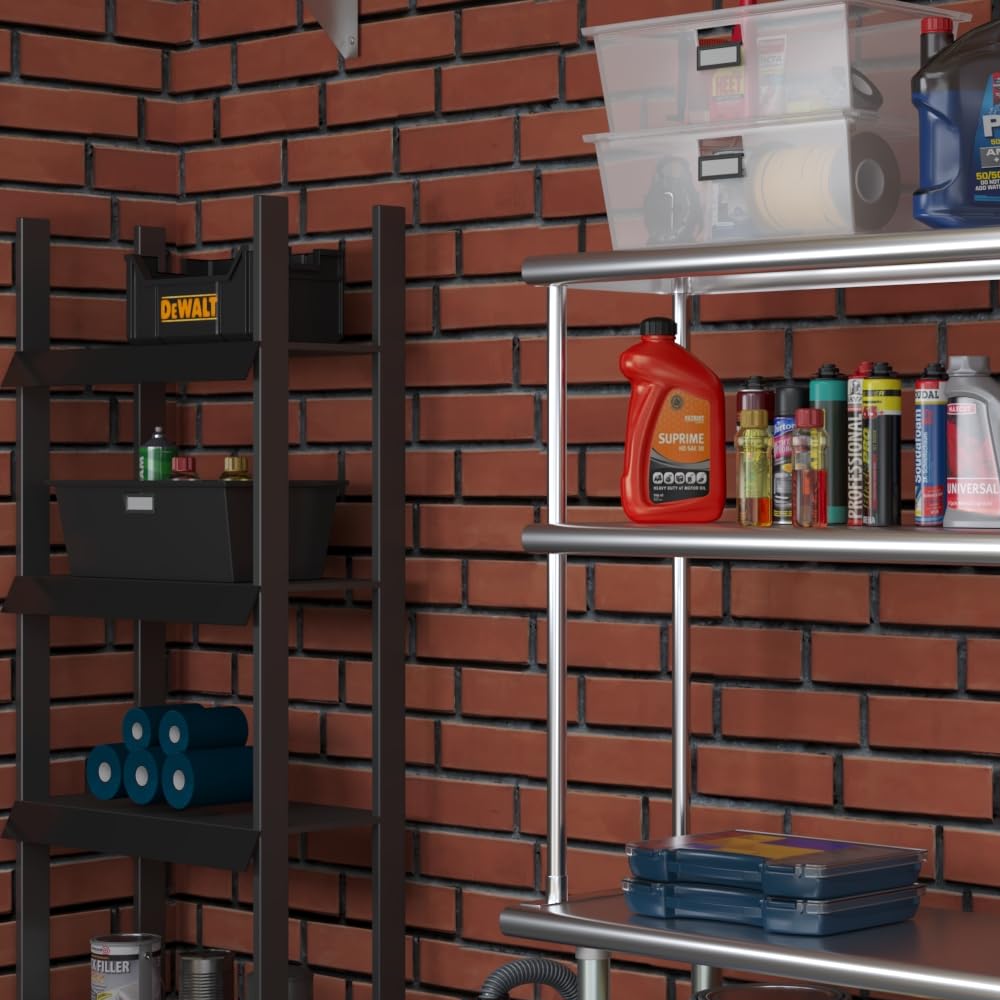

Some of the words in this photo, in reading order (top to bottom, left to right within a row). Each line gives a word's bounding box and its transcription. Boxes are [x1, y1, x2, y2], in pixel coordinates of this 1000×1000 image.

[658, 432, 705, 445] SUPRIME
[848, 414, 863, 519] PROFESSIONAL
[947, 483, 999, 495] UNIVERSAL
[97, 960, 130, 973] FILLER
